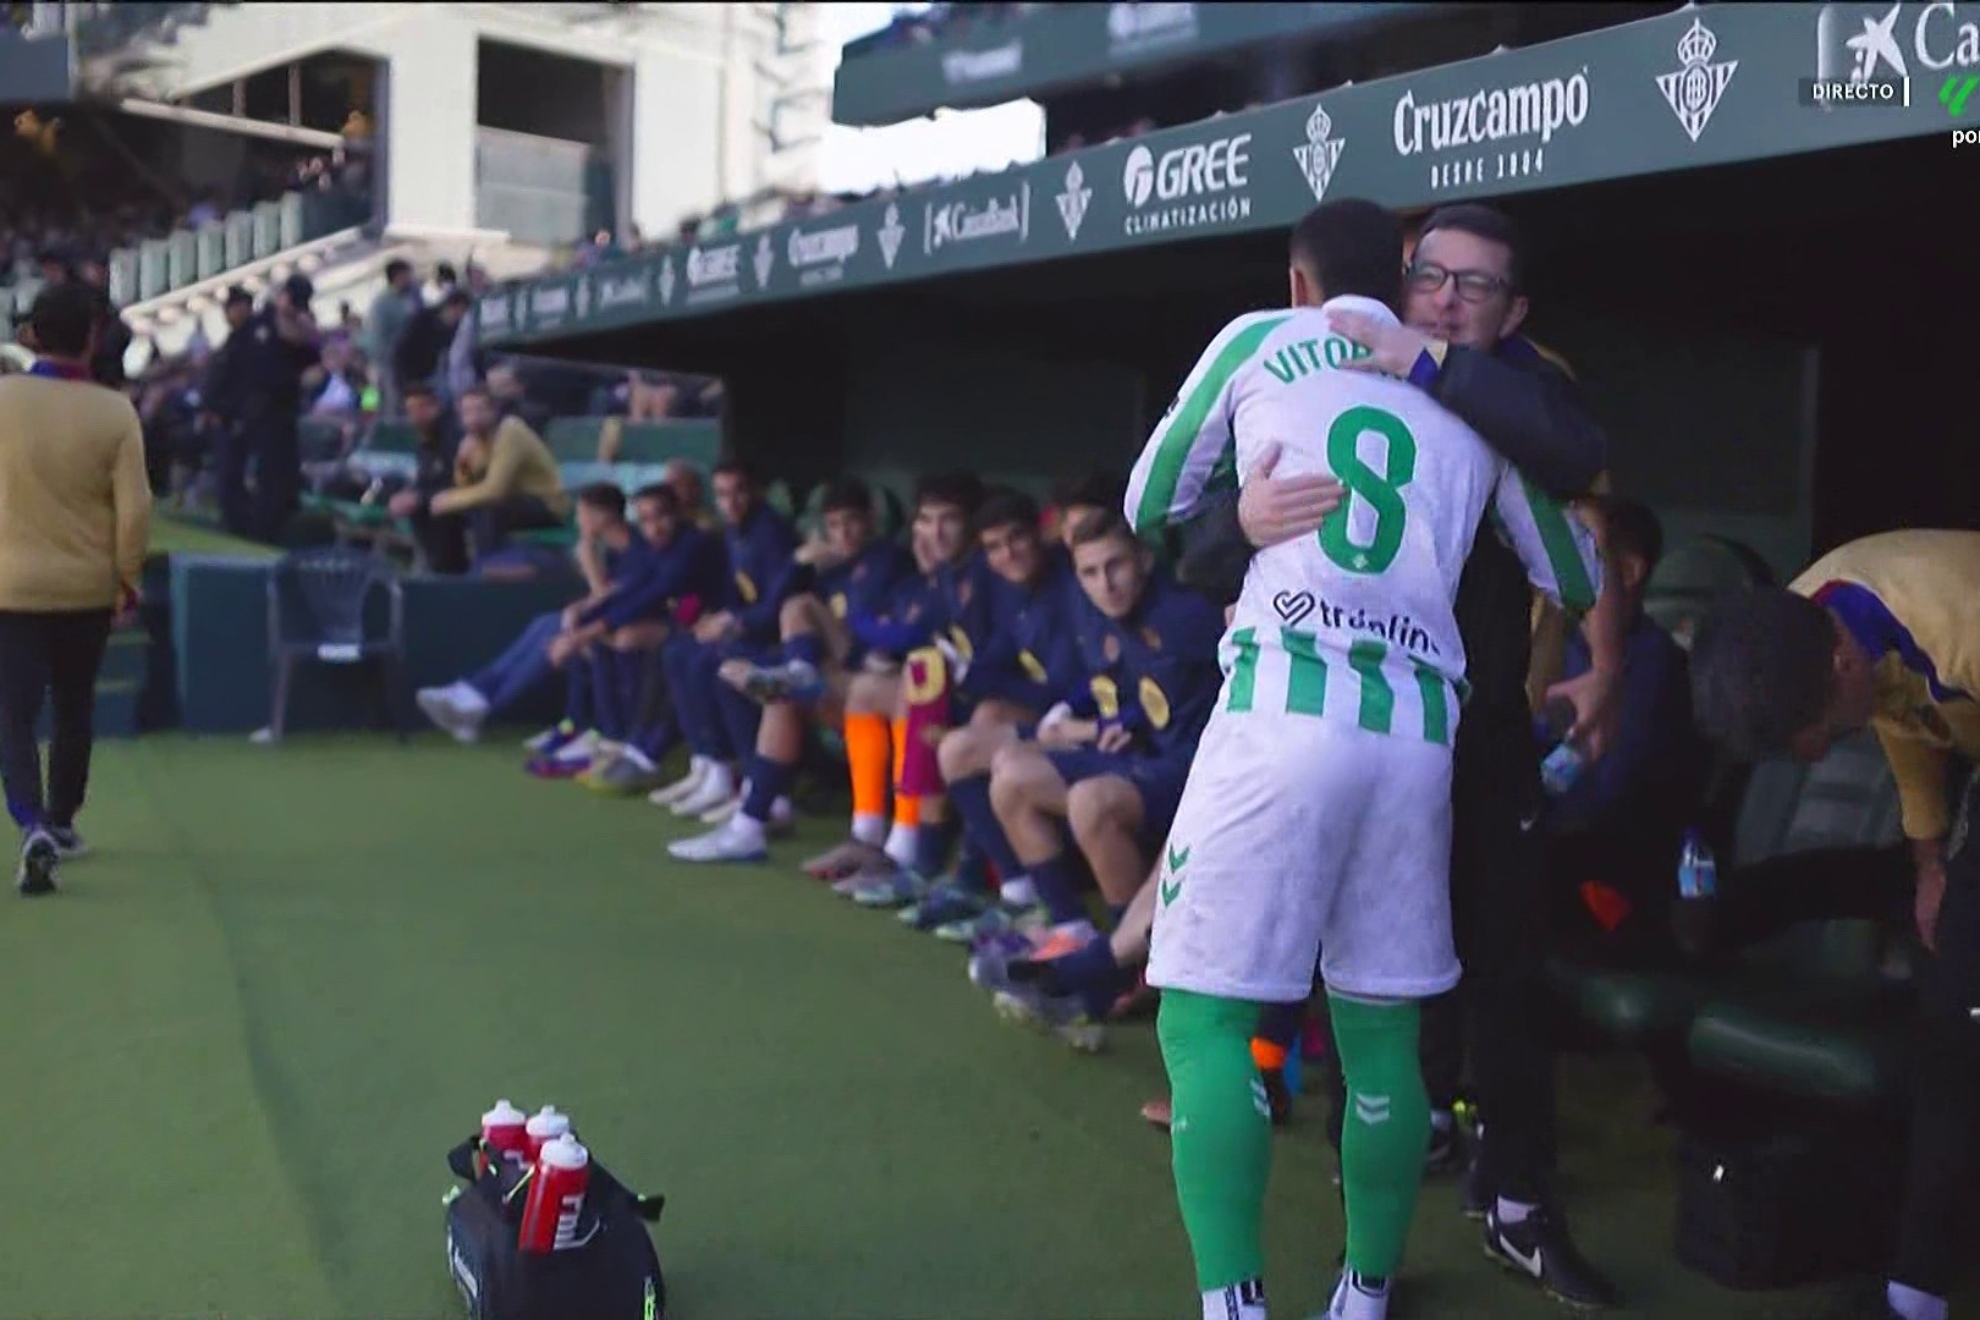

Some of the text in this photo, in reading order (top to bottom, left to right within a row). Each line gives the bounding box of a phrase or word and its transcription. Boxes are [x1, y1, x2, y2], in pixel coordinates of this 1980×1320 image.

[1394, 71, 1588, 156] Cruzcampo
[1156, 132, 1252, 200] GREE
[1430, 156, 1484, 190] DESDE
[1318, 404, 1417, 575] 8
